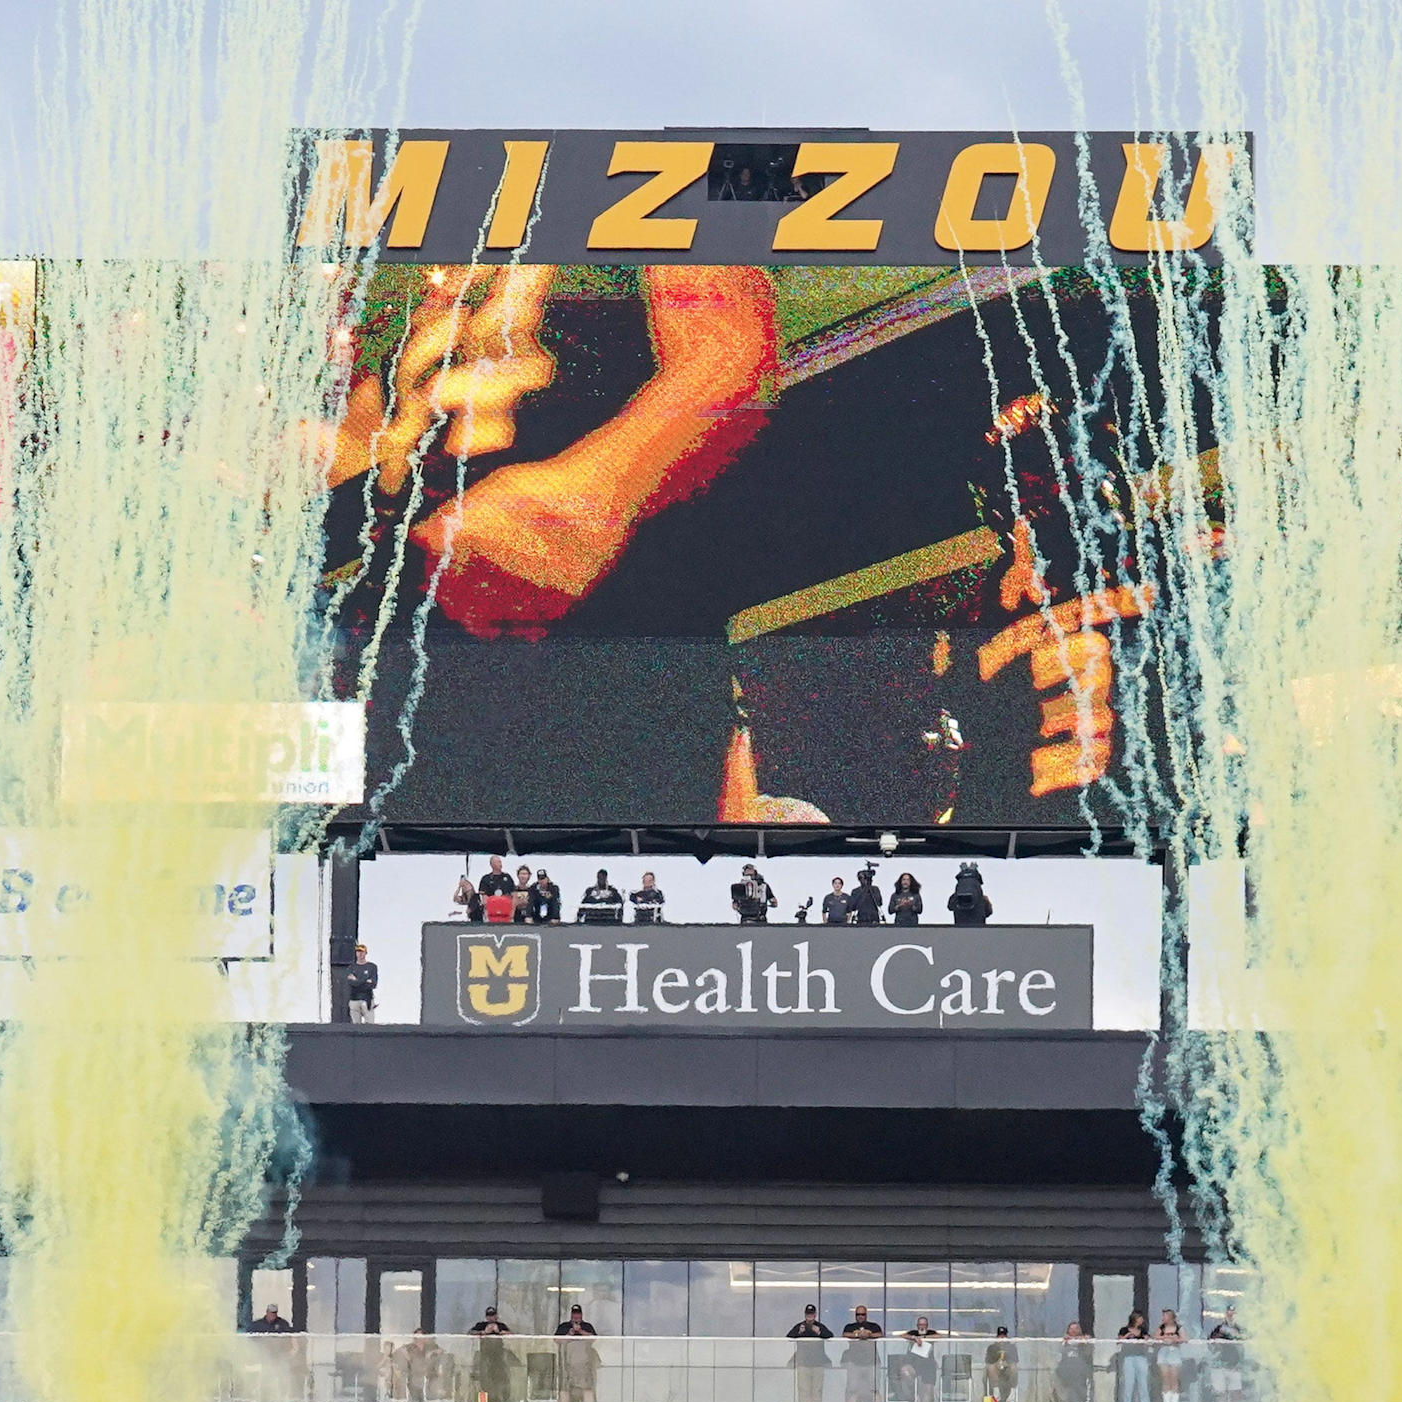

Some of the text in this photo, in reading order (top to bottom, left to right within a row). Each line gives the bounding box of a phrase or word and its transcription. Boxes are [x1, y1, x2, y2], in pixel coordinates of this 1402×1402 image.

[295, 140, 1234, 250] MIZZOU
[569, 940, 841, 1016] Health
[869, 943, 1058, 1018] Care
